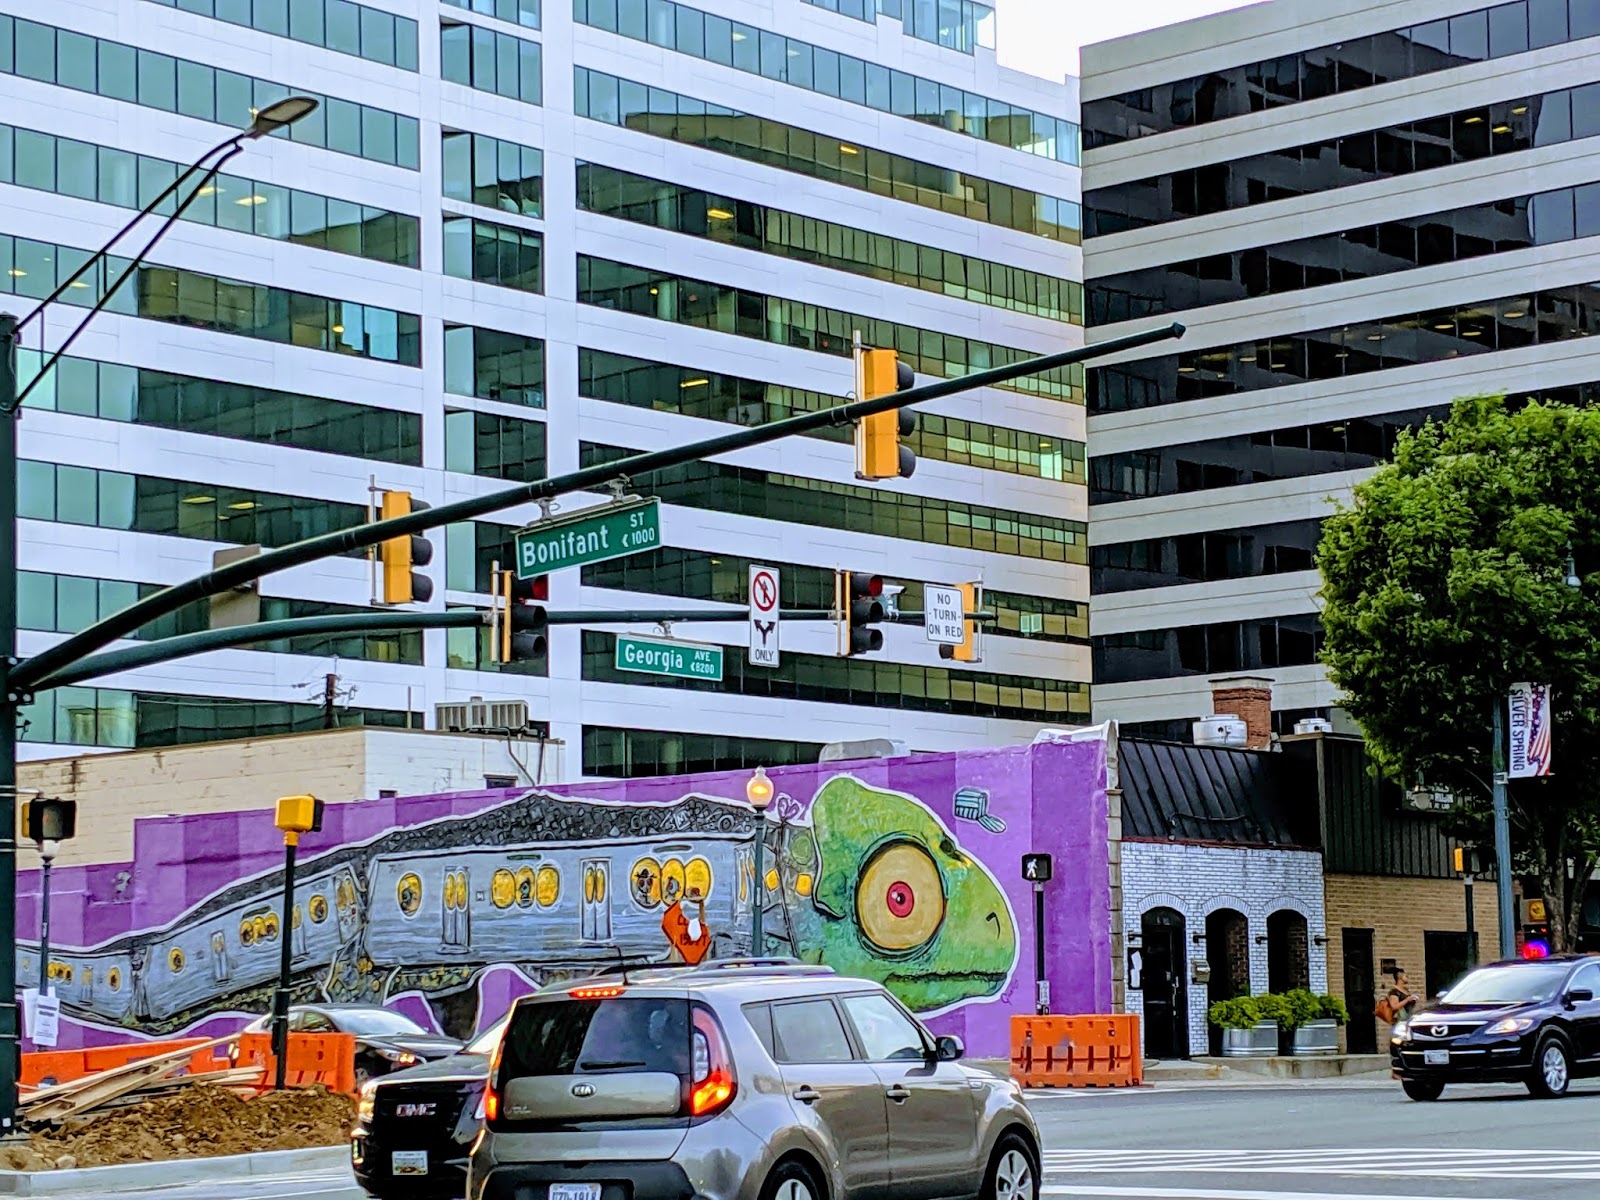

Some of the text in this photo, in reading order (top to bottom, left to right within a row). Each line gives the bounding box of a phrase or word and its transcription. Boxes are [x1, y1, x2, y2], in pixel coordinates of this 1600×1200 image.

[630, 511, 645, 527] ST
[632, 527, 655, 545] 1000
[522, 524, 609, 567] Bonifant
[937, 593, 951, 605] NO
[933, 608, 958, 621] TURN
[928, 624, 963, 638] ON RED
[624, 643, 683, 672] Georgia
[694, 651, 710, 662] AVE
[754, 649, 774, 662] ONLY
[695, 662, 715, 674] 8200
[1509, 688, 1526, 771] SILVER SPRING
[573, 1085, 593, 1097] KIA
[396, 1103, 437, 1117] GMC
